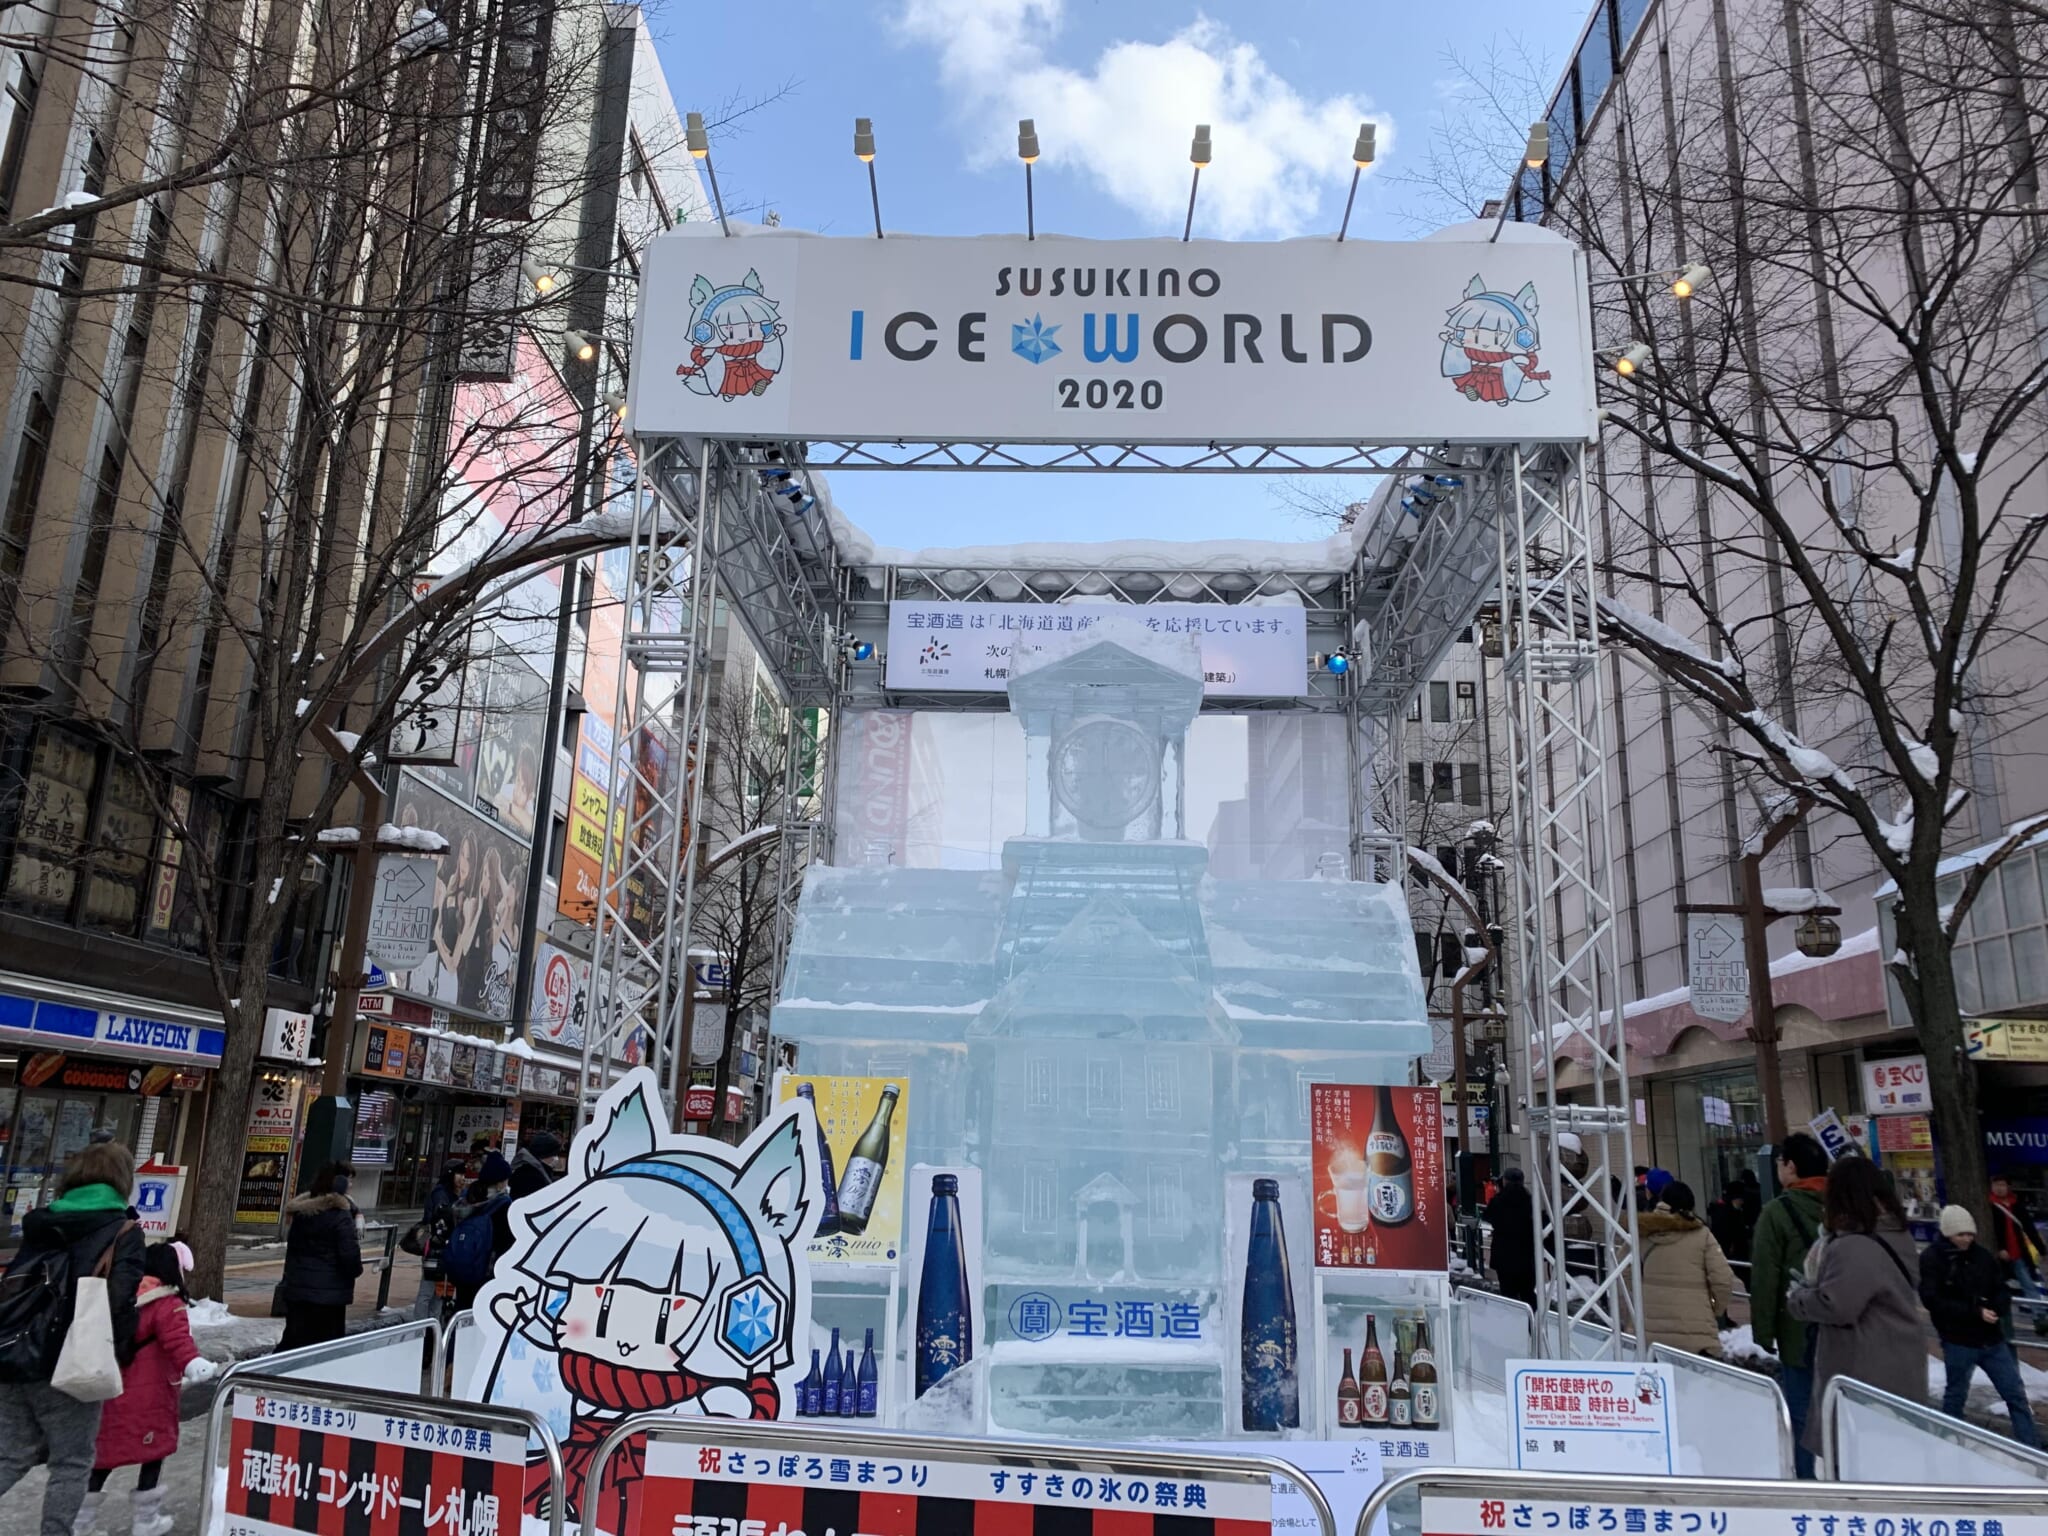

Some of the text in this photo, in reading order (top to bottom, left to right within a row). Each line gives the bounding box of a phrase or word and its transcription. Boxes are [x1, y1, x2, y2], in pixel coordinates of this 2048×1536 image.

[995, 267, 1221, 297] SUSUKINO
[850, 310, 1373, 364] ICE WORLD
[1058, 378, 1163, 410] 2020
[372, 920, 428, 940] SUSUKINO
[361, 998, 381, 1009] ATM
[105, 1015, 191, 1050] LAWSON
[271, 1108, 293, 1119] 入口
[1987, 1131, 2048, 1148] MEVIU
[1067, 1299, 1201, 1339] 宝酒造
[1525, 1376, 1613, 1394] 「開拓使時代の
[384, 1418, 492, 1454] すすきの氷の祭典
[1379, 1440, 1430, 1458] 宝酒造
[990, 1470, 1207, 1509] すすきの氷の祭典
